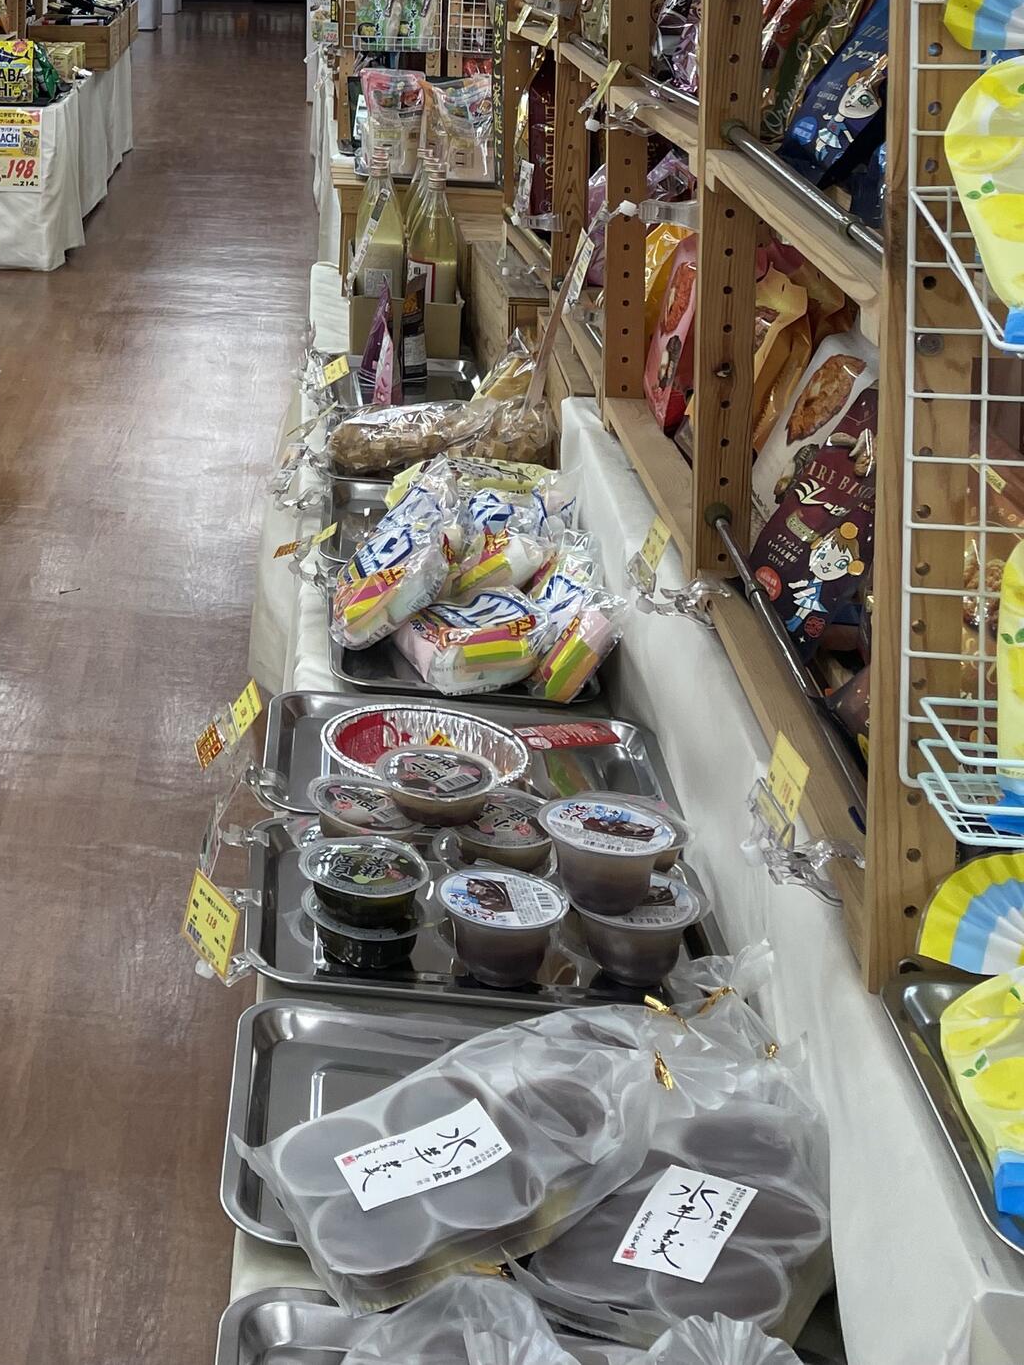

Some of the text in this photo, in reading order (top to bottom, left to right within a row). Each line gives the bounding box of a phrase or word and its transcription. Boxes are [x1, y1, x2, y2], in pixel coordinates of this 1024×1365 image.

[6, 159, 36, 179] 198
[205, 913, 218, 930] 118
[651, 1179, 720, 1269] 水羊羹
